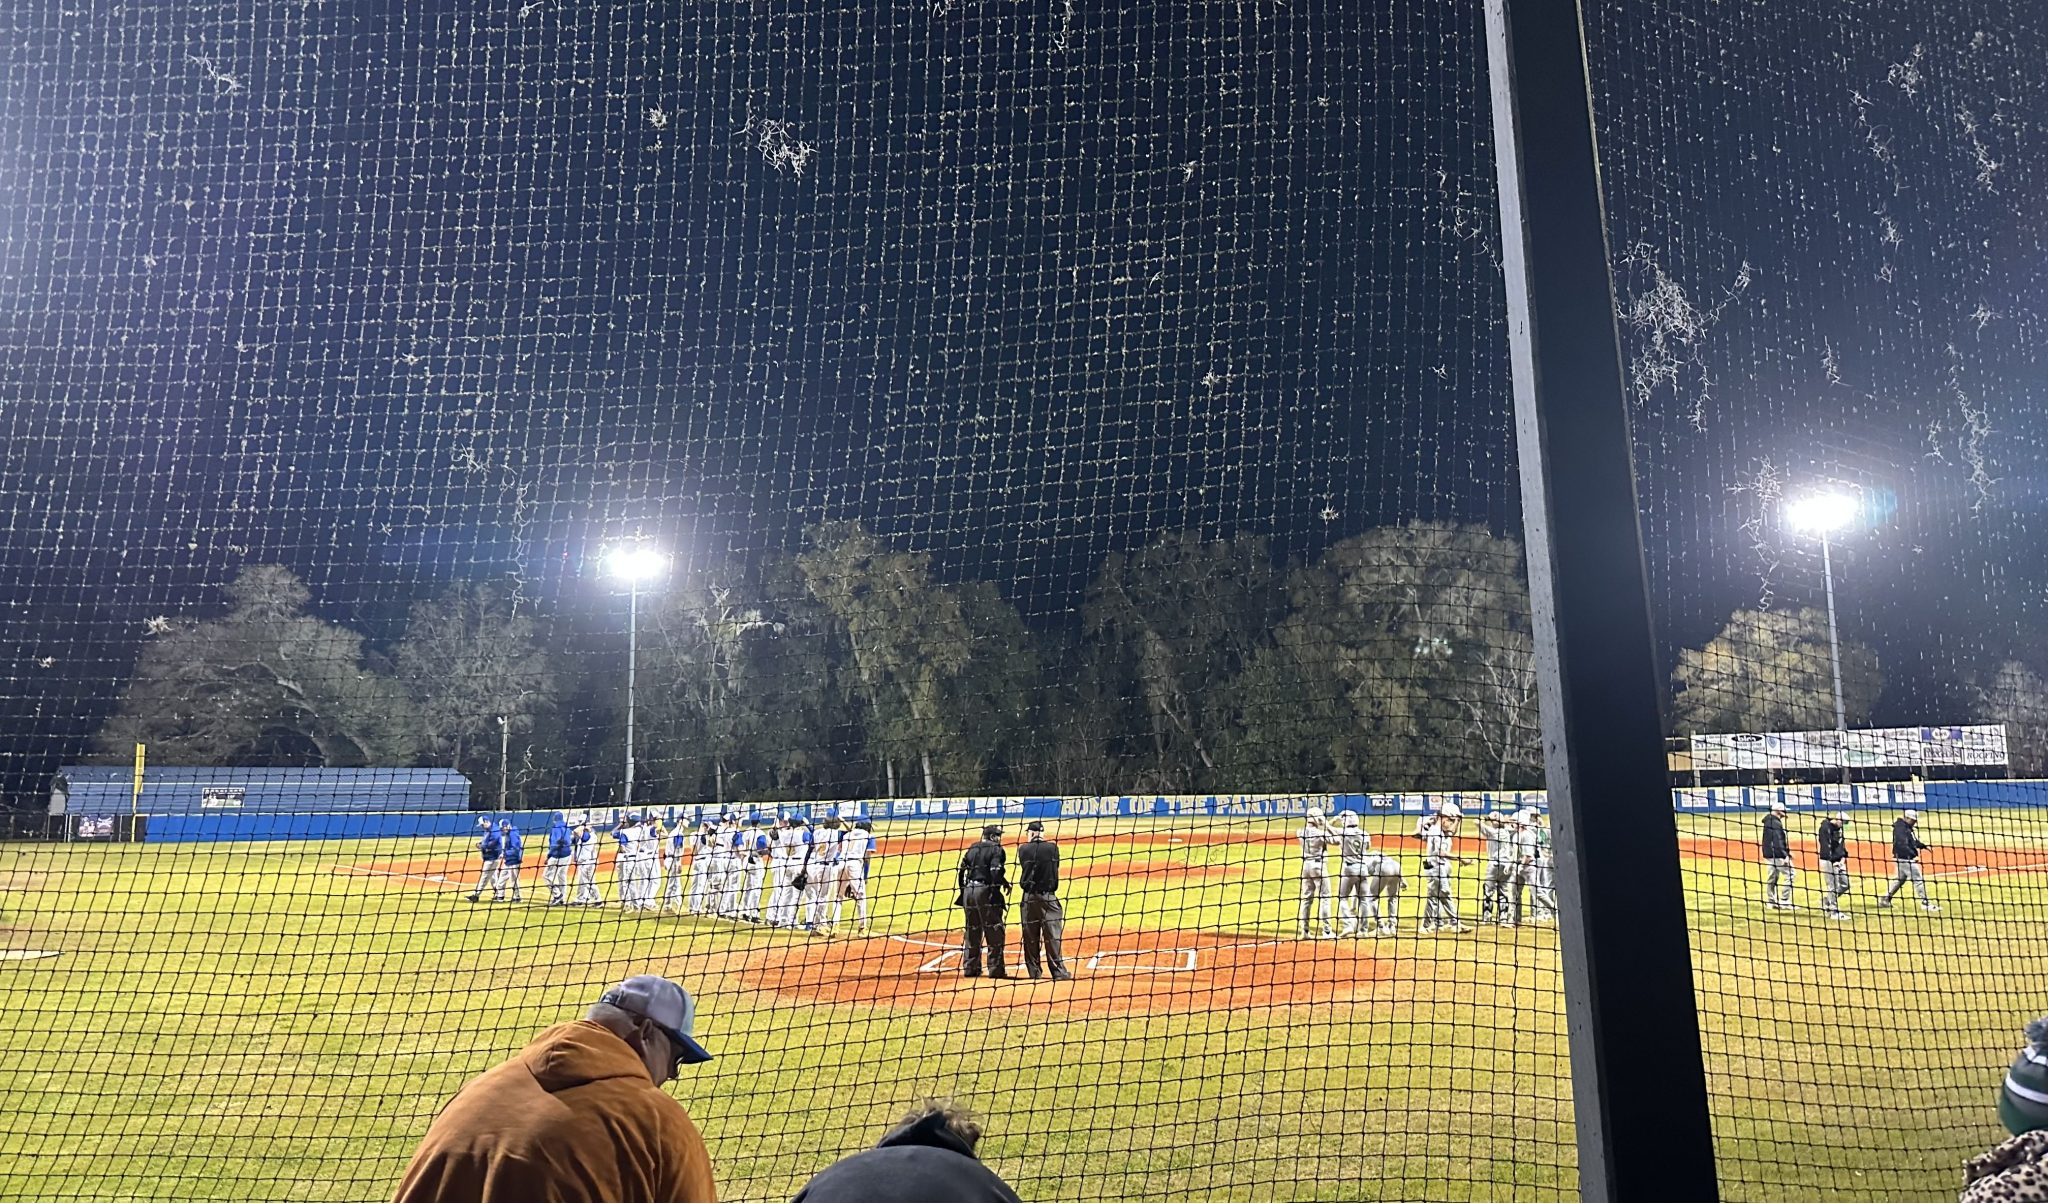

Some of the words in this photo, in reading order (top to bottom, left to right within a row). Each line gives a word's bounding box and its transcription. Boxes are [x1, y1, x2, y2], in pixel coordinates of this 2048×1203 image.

[1061, 798, 1119, 815] HOME
[1130, 797, 1154, 814] OF
[1165, 797, 1208, 814] THE
[1216, 796, 1335, 814] PANTHERS
